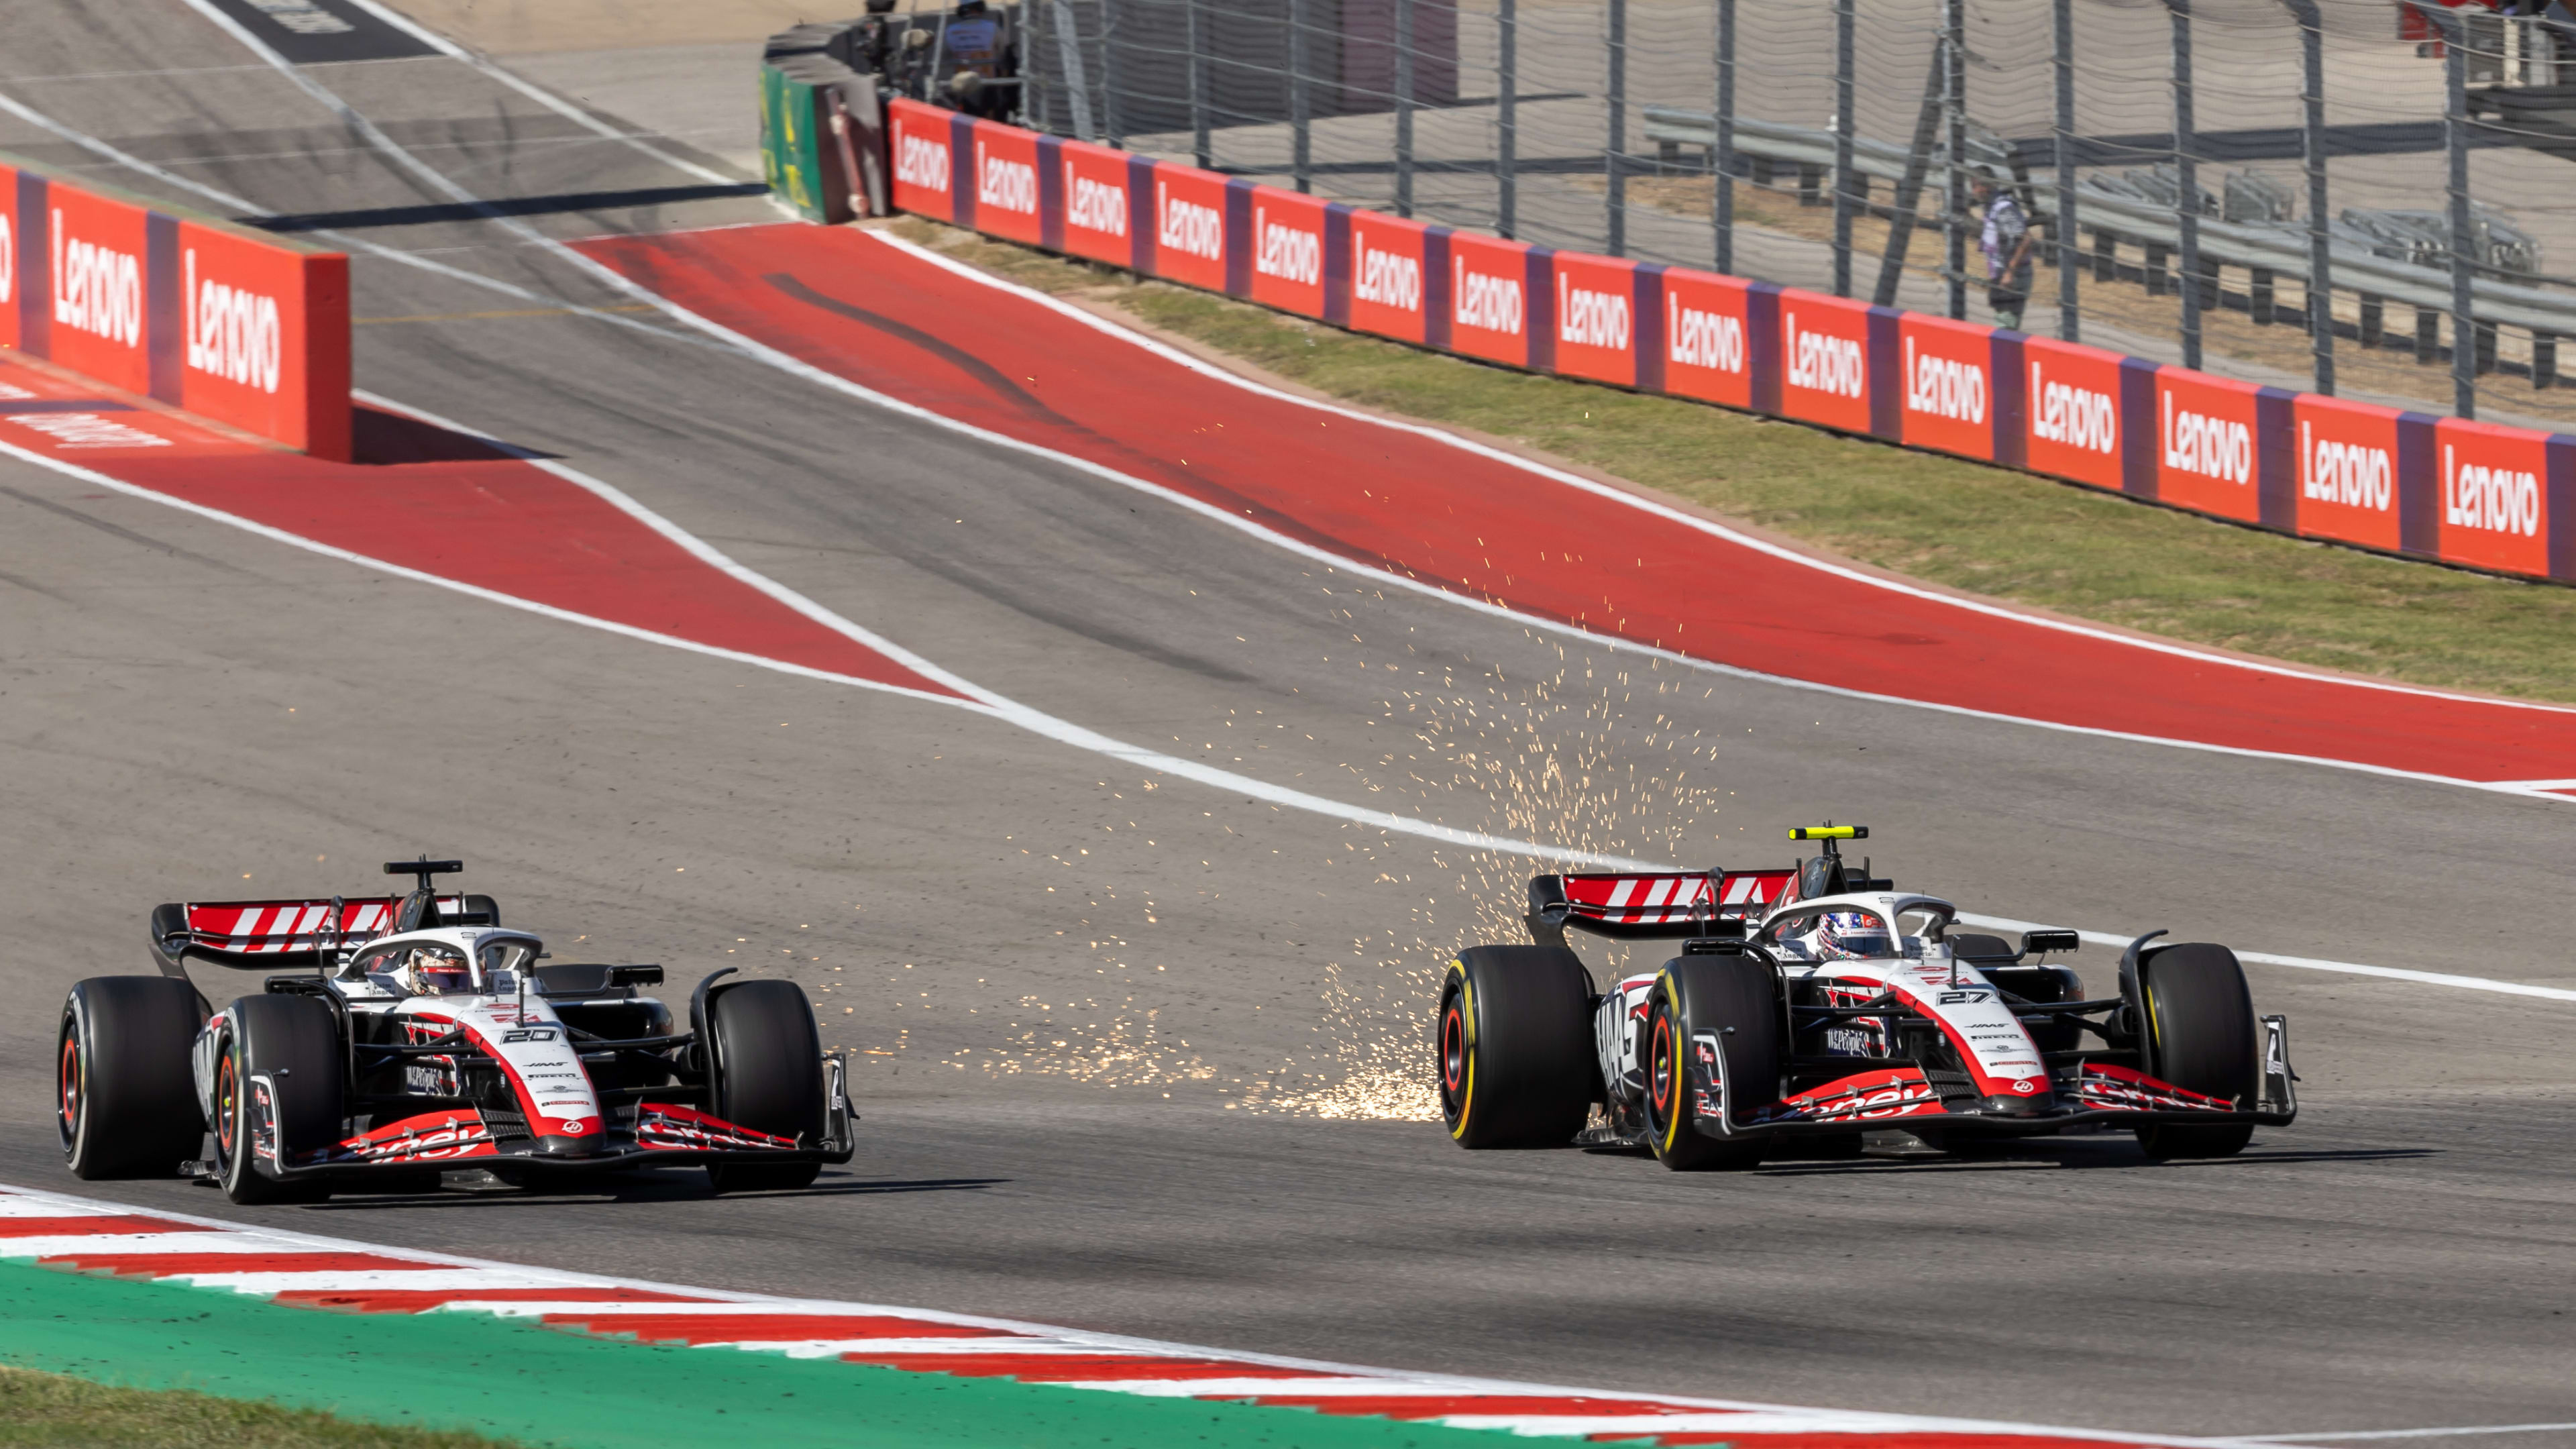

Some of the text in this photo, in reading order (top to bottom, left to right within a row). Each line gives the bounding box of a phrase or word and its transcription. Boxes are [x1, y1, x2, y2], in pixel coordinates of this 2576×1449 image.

[895, 119, 949, 192] Lenovo
[979, 142, 1035, 213] Lenovo
[1067, 162, 1126, 236] Lenovo
[1159, 182, 1221, 260] Lenovo
[52, 209, 141, 347] Lenovo
[1256, 207, 1319, 285] Lenovo
[1356, 232, 1419, 311] Lenovo
[185, 248, 280, 394] Lenovo
[1456, 256, 1521, 334] Lenovo
[1560, 272, 1628, 350] Lenovo
[1670, 292, 1742, 373] Lenovo
[1787, 313, 1862, 398] Lenovo
[1907, 337, 1984, 424] Lenovo
[2033, 362, 2114, 453] Lenovo
[2165, 390, 2251, 484] Lenovo
[2303, 421, 2390, 511] Lenovo
[2445, 445, 2538, 536] Lenovo
[499, 1030, 560, 1044] 20
[1936, 991, 1994, 1006] 27
